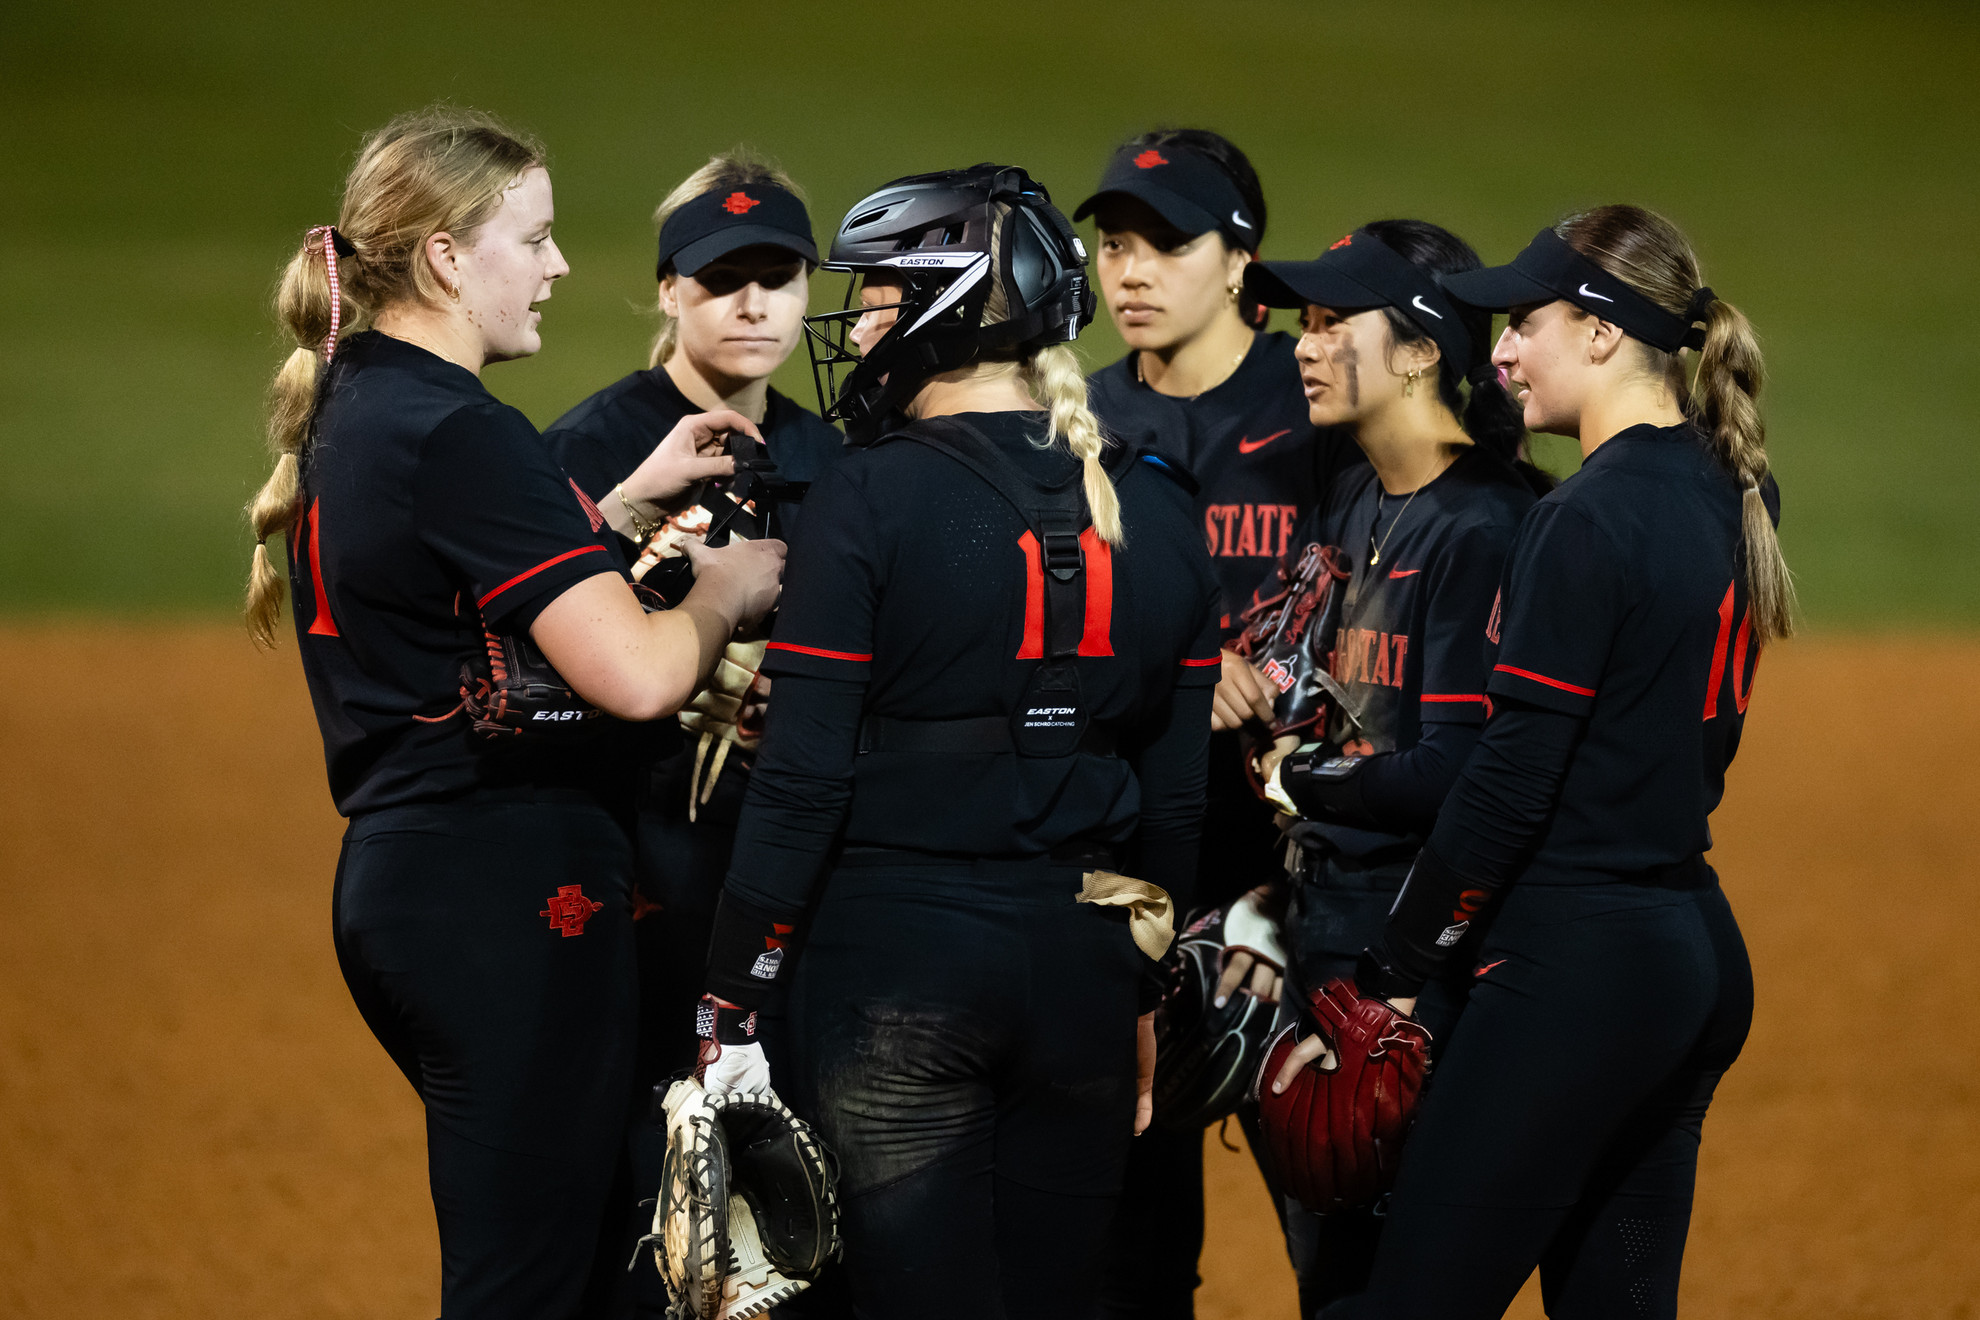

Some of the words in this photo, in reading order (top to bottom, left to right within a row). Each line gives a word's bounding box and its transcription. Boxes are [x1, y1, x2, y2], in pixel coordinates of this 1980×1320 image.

[900, 258, 945, 266] EASTON
[1205, 504, 1298, 557] STATE
[1026, 707, 1076, 715] EASTON
